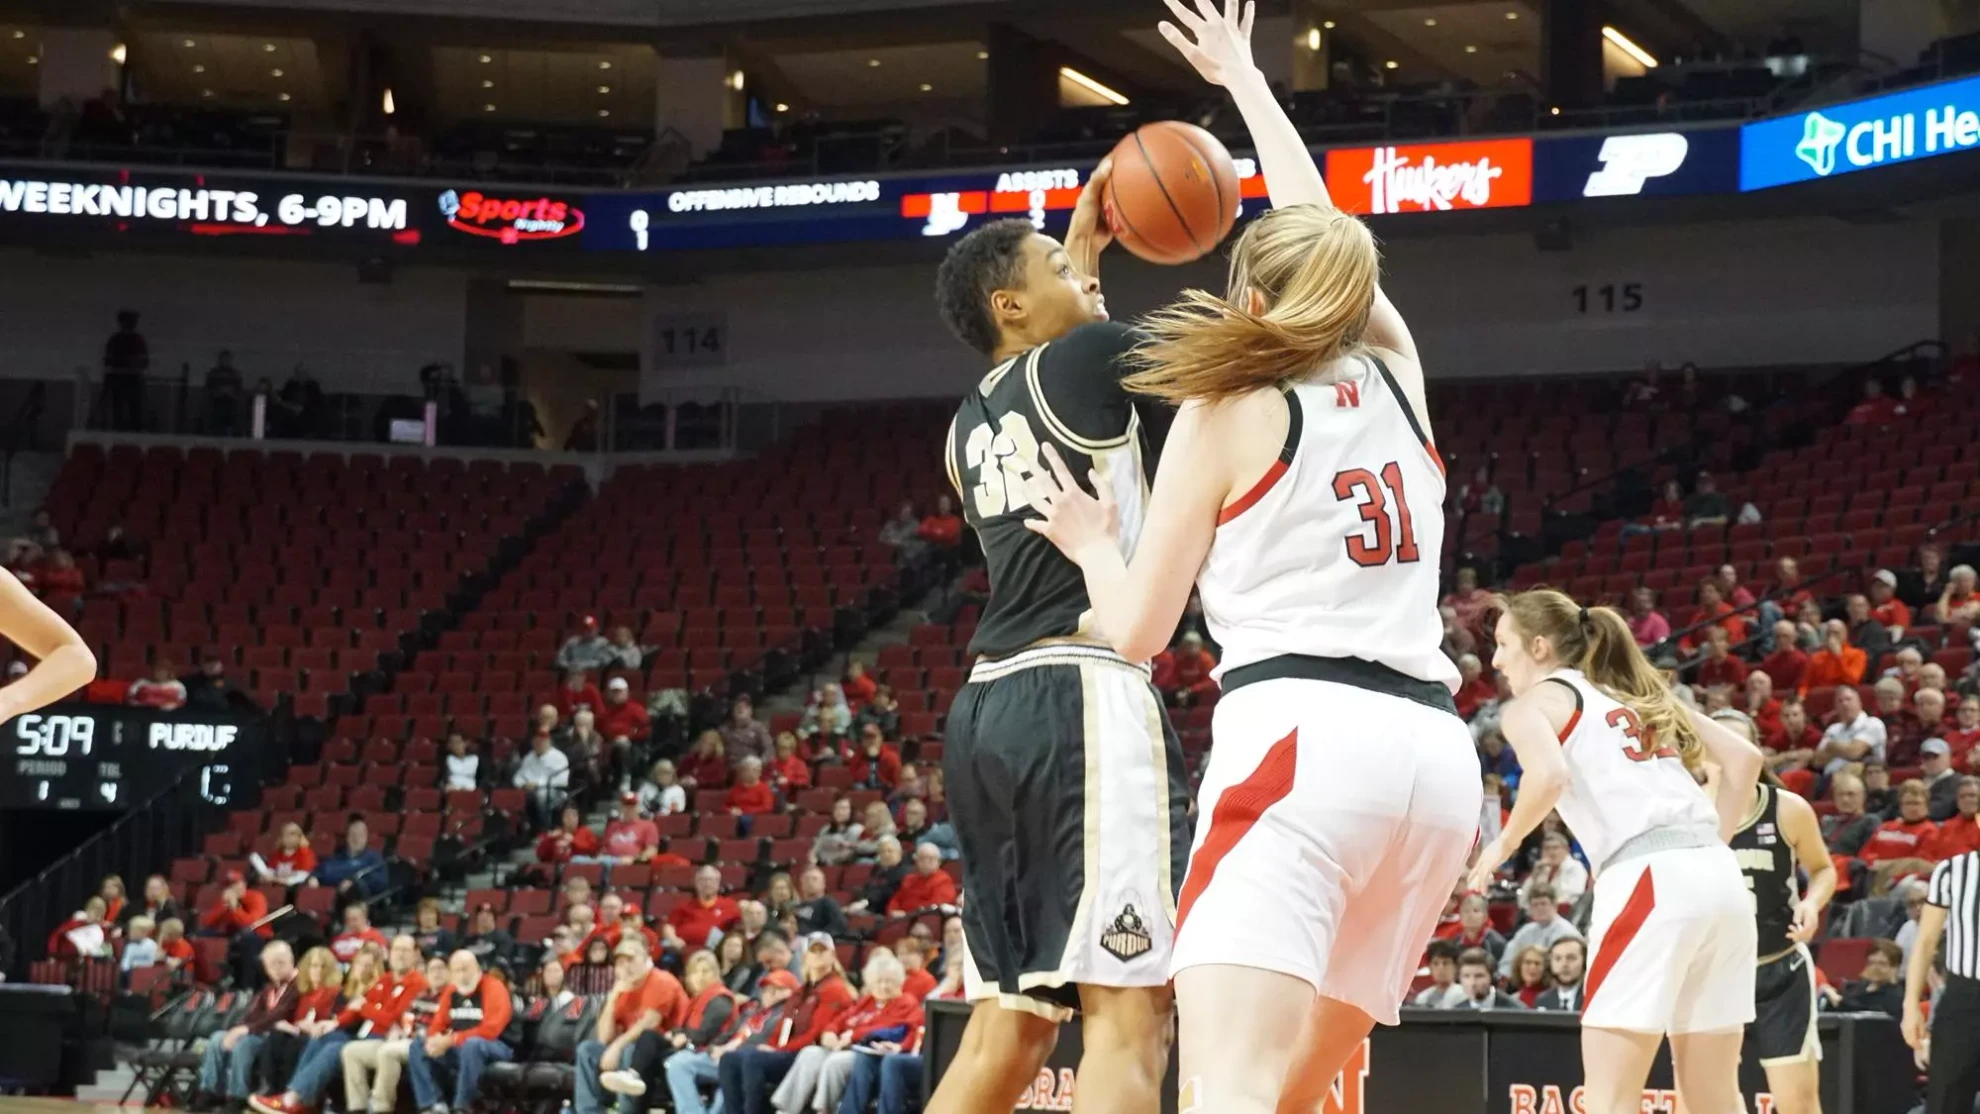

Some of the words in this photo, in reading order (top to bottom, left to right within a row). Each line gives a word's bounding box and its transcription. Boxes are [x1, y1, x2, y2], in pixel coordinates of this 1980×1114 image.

[1846, 113, 1915, 166] CHI
[1925, 105, 1980, 152] He
[668, 187, 774, 212] OFFENSIVE
[774, 180, 880, 206] REBOUNDS
[995, 168, 1079, 193] ASSISTS
[1363, 147, 1502, 214] Huskers
[278, 194, 407, 229] 6-9PM
[458, 192, 567, 224] Sports
[1572, 284, 1643, 313] 115
[661, 327, 720, 353] 114
[1335, 379, 1360, 408] N
[1331, 461, 1420, 567] 31
[16, 714, 95, 756] 5:09
[1102, 932, 1150, 957] PURDUE
